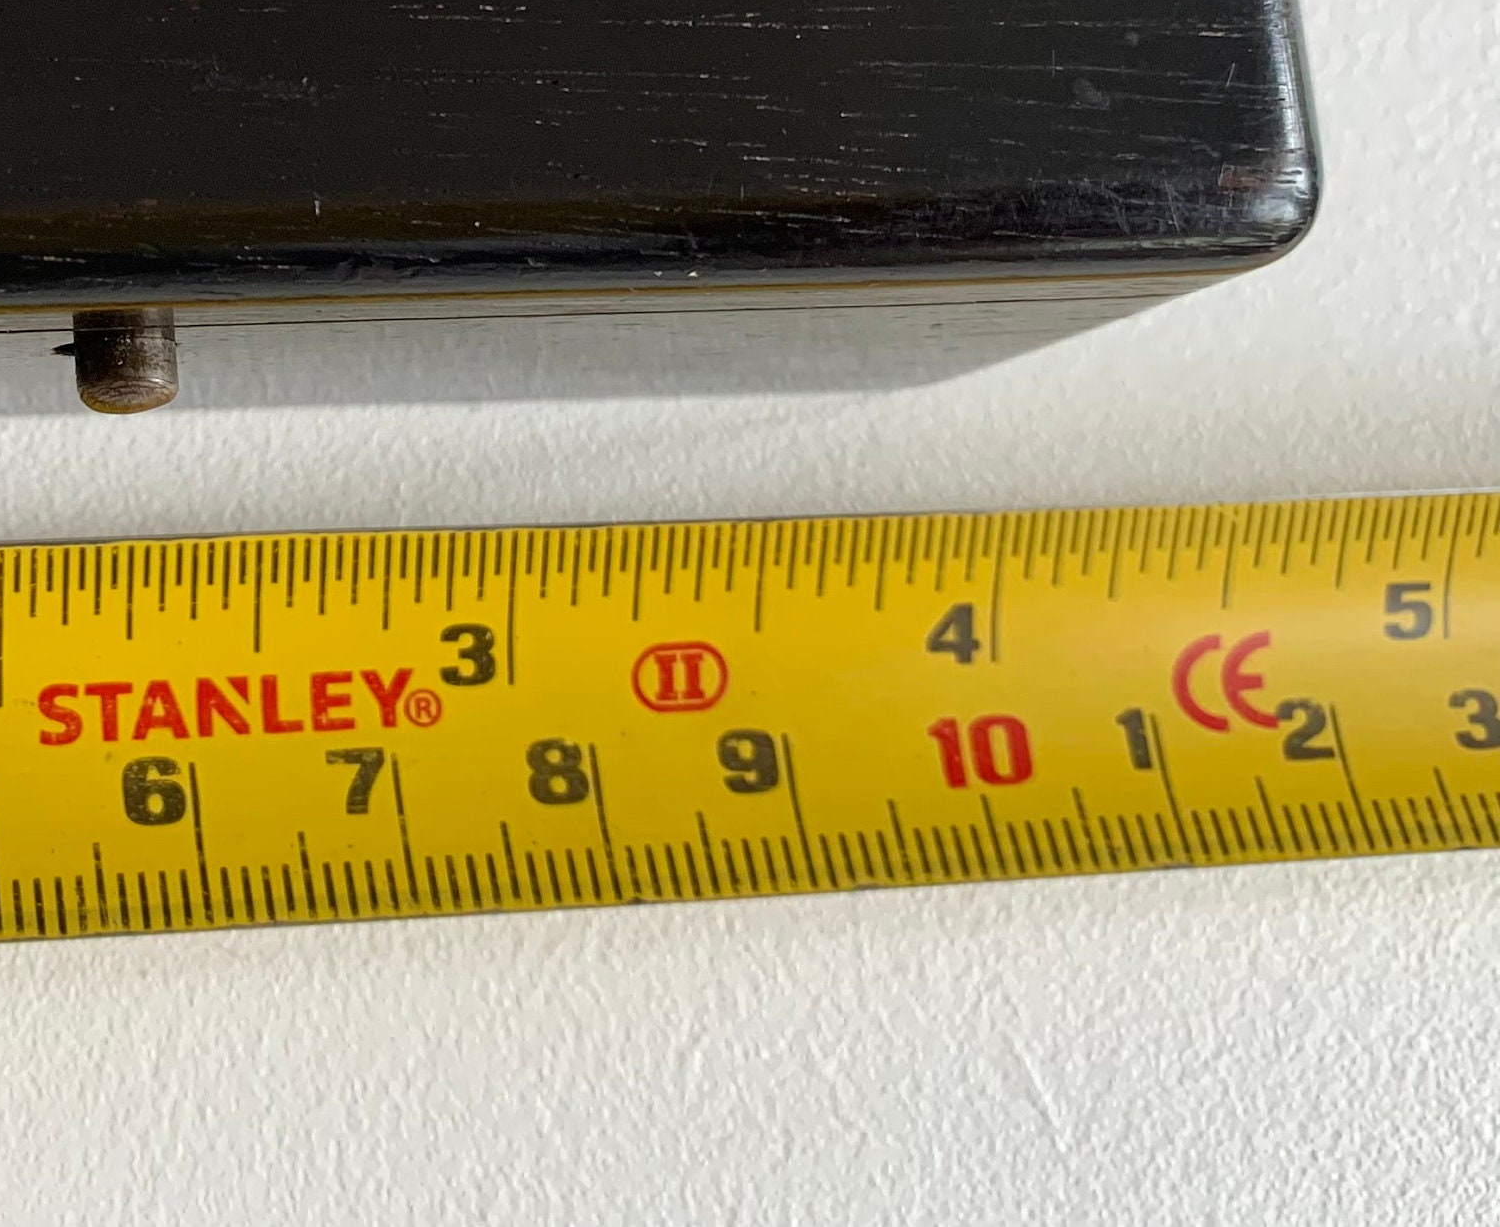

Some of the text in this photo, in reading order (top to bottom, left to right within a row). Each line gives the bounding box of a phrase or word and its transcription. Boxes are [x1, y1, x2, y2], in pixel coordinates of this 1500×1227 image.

[925, 603, 980, 664] 4
[1383, 582, 1433, 640] 5
[439, 623, 496, 686] 3
[1115, 708, 1153, 770] 1
[1274, 698, 1335, 761] 2
[1448, 690, 1500, 750] 3
[325, 747, 385, 815] 7
[525, 738, 590, 805] 8
[716, 729, 779, 794] 9
[927, 715, 1034, 789] 10
[121, 756, 187, 826] 6
